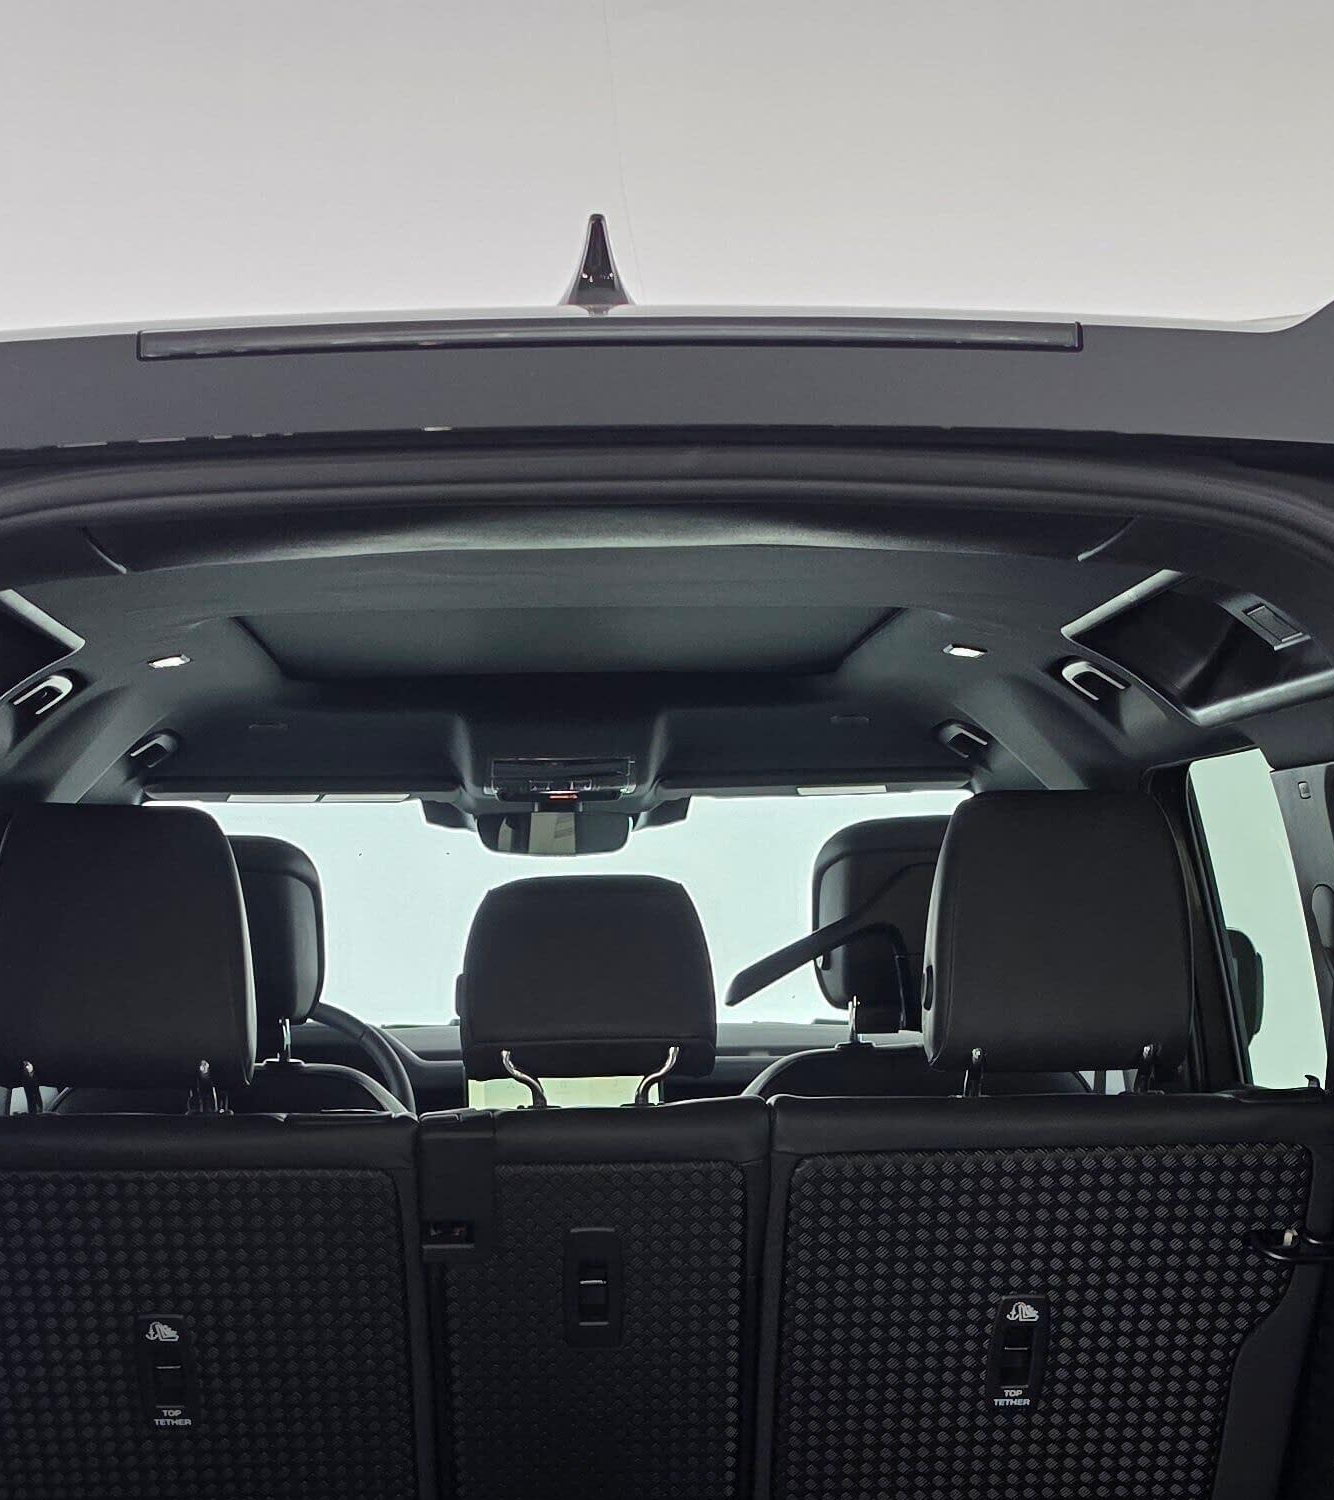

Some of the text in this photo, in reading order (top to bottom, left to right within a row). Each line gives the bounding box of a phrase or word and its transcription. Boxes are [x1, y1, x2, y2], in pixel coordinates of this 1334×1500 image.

[1003, 1389, 1023, 1397] TOP
[993, 1398, 1031, 1406] TETHER
[161, 1409, 182, 1417] TOP
[154, 1418, 192, 1426] TETHER
